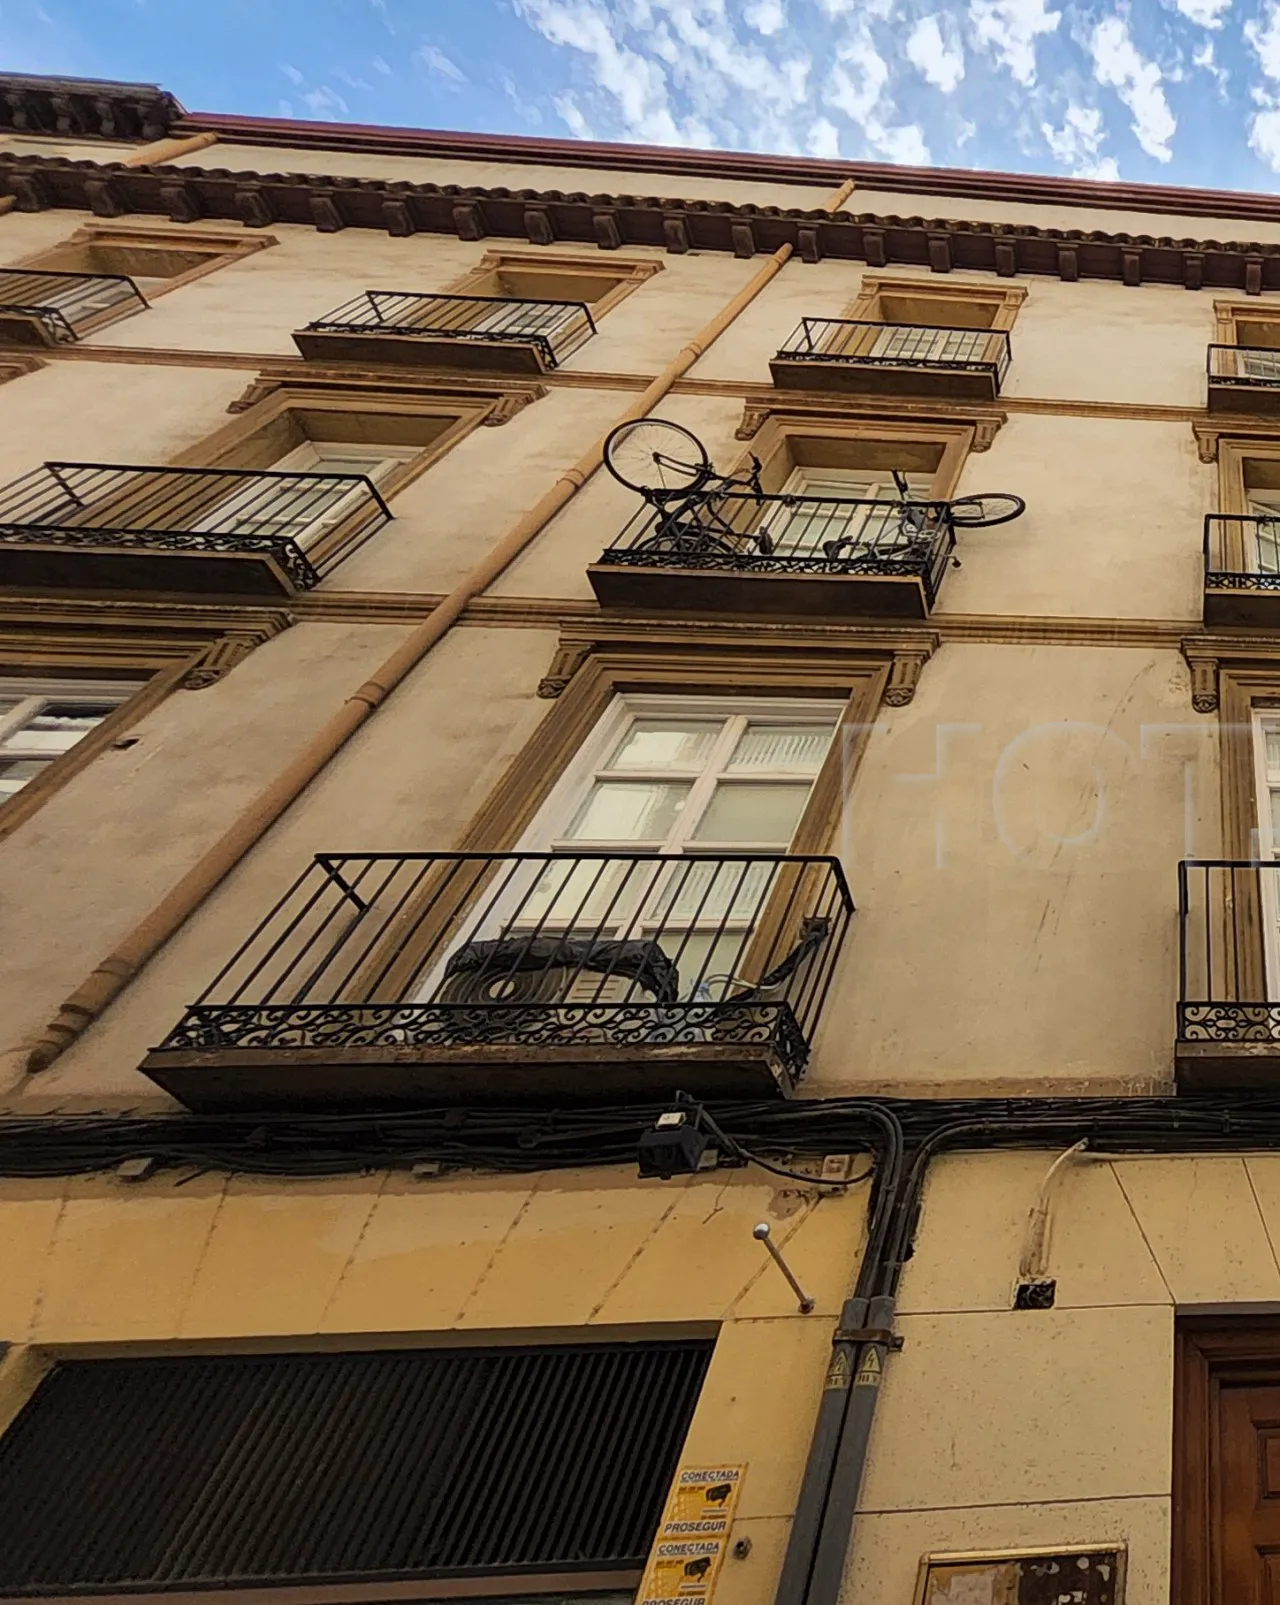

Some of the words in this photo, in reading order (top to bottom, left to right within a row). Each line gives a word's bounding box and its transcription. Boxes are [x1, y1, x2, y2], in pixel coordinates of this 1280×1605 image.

[680, 1470, 740, 1481] CONECTADA
[664, 1520, 727, 1533] PROSEGUR
[658, 1542, 720, 1553] CONECTADA
